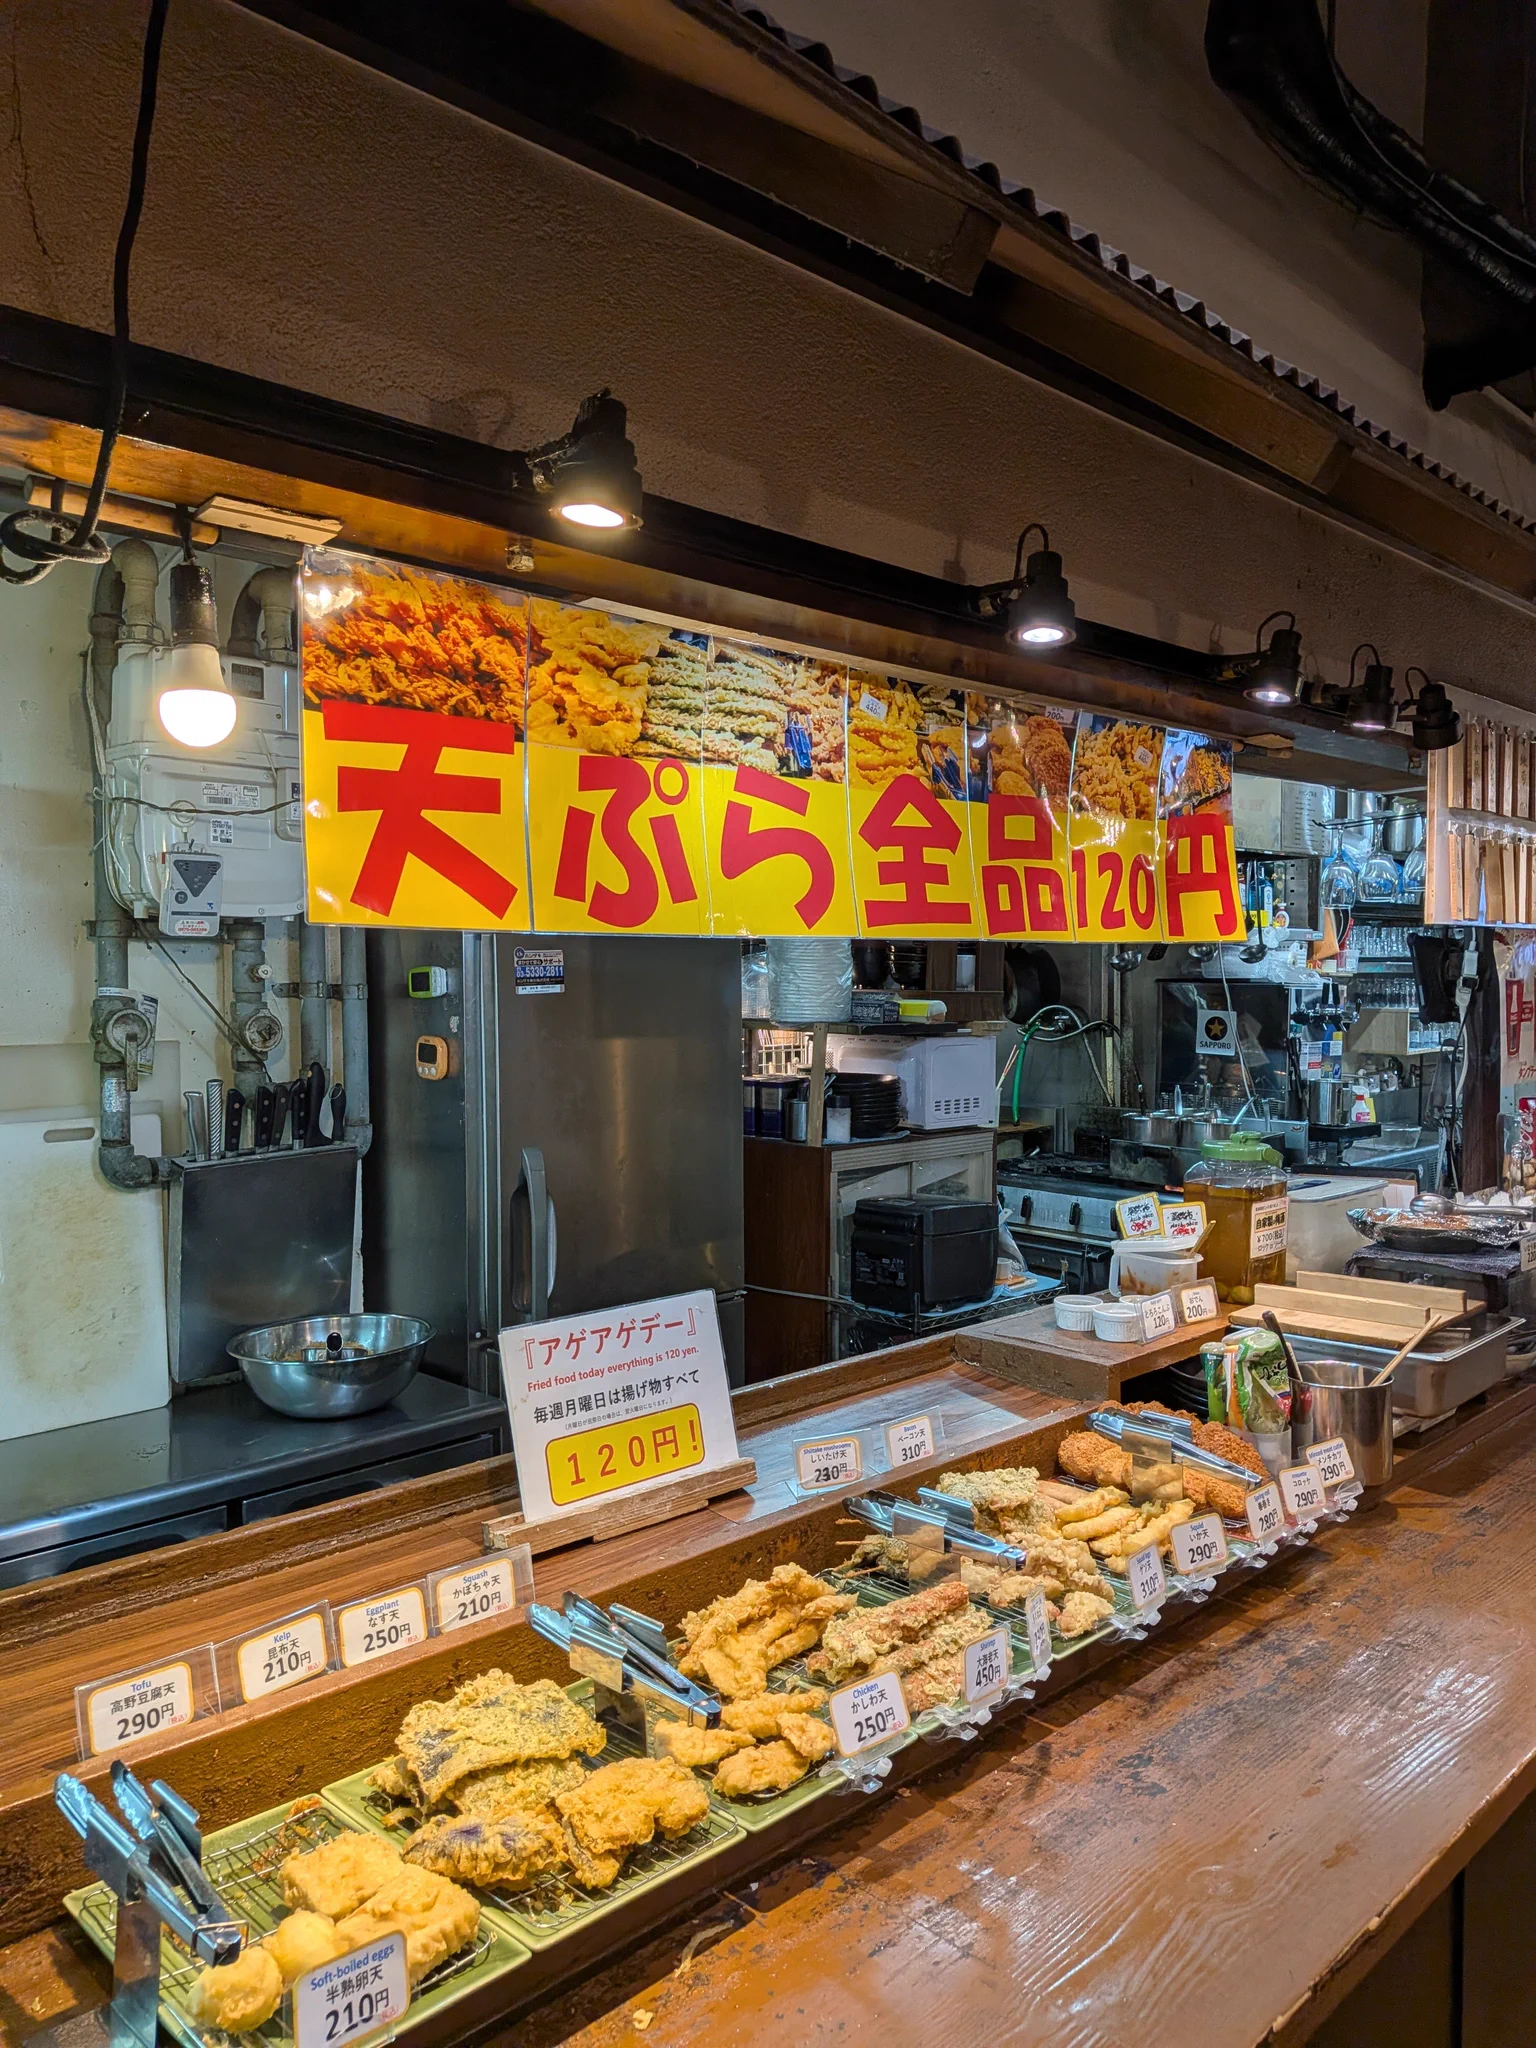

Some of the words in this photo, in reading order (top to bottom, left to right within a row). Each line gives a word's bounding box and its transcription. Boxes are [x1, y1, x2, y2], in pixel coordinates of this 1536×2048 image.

[322, 699, 1237, 937] 天ぷら全品120円
[1199, 1041, 1232, 1050] SAPPORO
[1153, 1314, 1170, 1330] 120円
[1187, 1304, 1208, 1319] 200円
[524, 1307, 697, 1370] 『アゲアゲデー』
[527, 1377, 552, 1393] Fried
[554, 1372, 577, 1387] food
[578, 1366, 606, 1383] today
[607, 1355, 655, 1374] everything
[655, 1350, 663, 1363] is
[664, 1348, 681, 1361] 120
[681, 1346, 700, 1359] yen.
[533, 1369, 701, 1424] 毎週月曜日は揚げ物すべて
[897, 1428, 926, 1443] ベーコン天
[903, 1424, 917, 1433] Bacon
[810, 1449, 848, 1464] しいたけ天
[901, 1440, 927, 1462] 310円
[1317, 1451, 1342, 1465] メンチカツ
[1293, 1477, 1311, 1487] コロッケ
[1321, 1460, 1347, 1481] 290円
[1294, 1488, 1319, 1508] 290円
[1189, 1521, 1205, 1533] Squid
[1258, 1507, 1279, 1533] 280円
[1188, 1528, 1210, 1543] いか天
[1188, 1541, 1218, 1565] 290円
[452, 1574, 502, 1600] かぼちゃ天
[463, 1569, 488, 1584] Squash
[1140, 1572, 1160, 1600] 310円
[365, 1599, 400, 1616] Eggplant
[457, 1590, 502, 1621] 210円
[368, 1608, 400, 1628] なす天
[273, 1630, 291, 1644] Kelp
[363, 1622, 412, 1653] 250円
[267, 1637, 301, 1662] 昆布天
[263, 1650, 312, 1683] 210円
[975, 1663, 1001, 1687] 450円
[110, 1681, 176, 1716] 高野豆腐天
[130, 1680, 152, 1693] Tofu
[852, 1682, 879, 1699] Chicken
[851, 1688, 888, 1715] かしわ天
[117, 1702, 175, 1741] 290円
[854, 1706, 896, 1743] 250円
[310, 1952, 369, 1991] Soft-boiled
[371, 1943, 395, 1962] eggs
[325, 1963, 384, 2004] 半熟卵天
[325, 1987, 390, 2042] 210円
